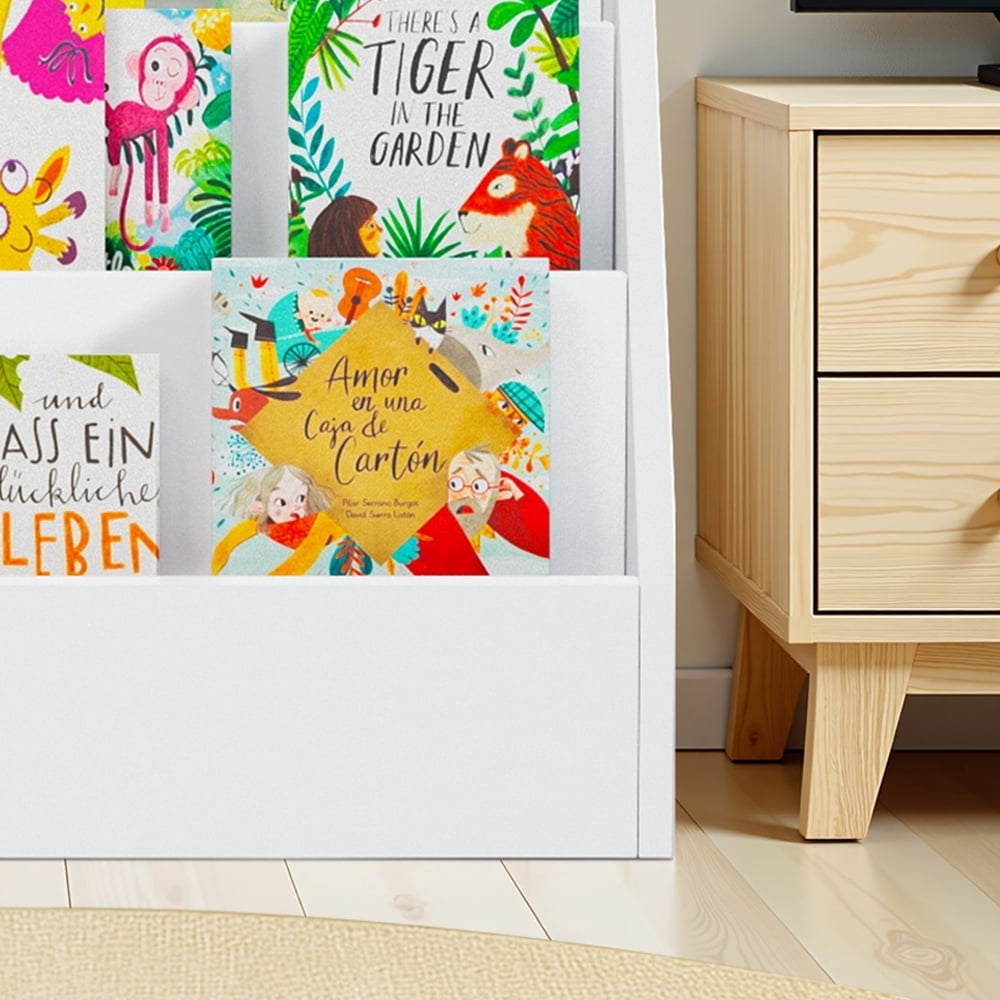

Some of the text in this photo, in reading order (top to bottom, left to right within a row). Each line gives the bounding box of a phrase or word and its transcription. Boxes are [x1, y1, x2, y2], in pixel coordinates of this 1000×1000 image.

[386, 9, 481, 34] THERE'S A
[363, 37, 495, 101] TIGER
[390, 100, 465, 127] IN THE
[369, 130, 491, 169] GARDEN
[324, 355, 408, 395] Amor
[32, 381, 113, 411] und
[351, 393, 427, 413] en una
[304, 408, 388, 449] Caja de
[334, 435, 450, 486] Cartón
[1, 511, 160, 576] LEBEN
